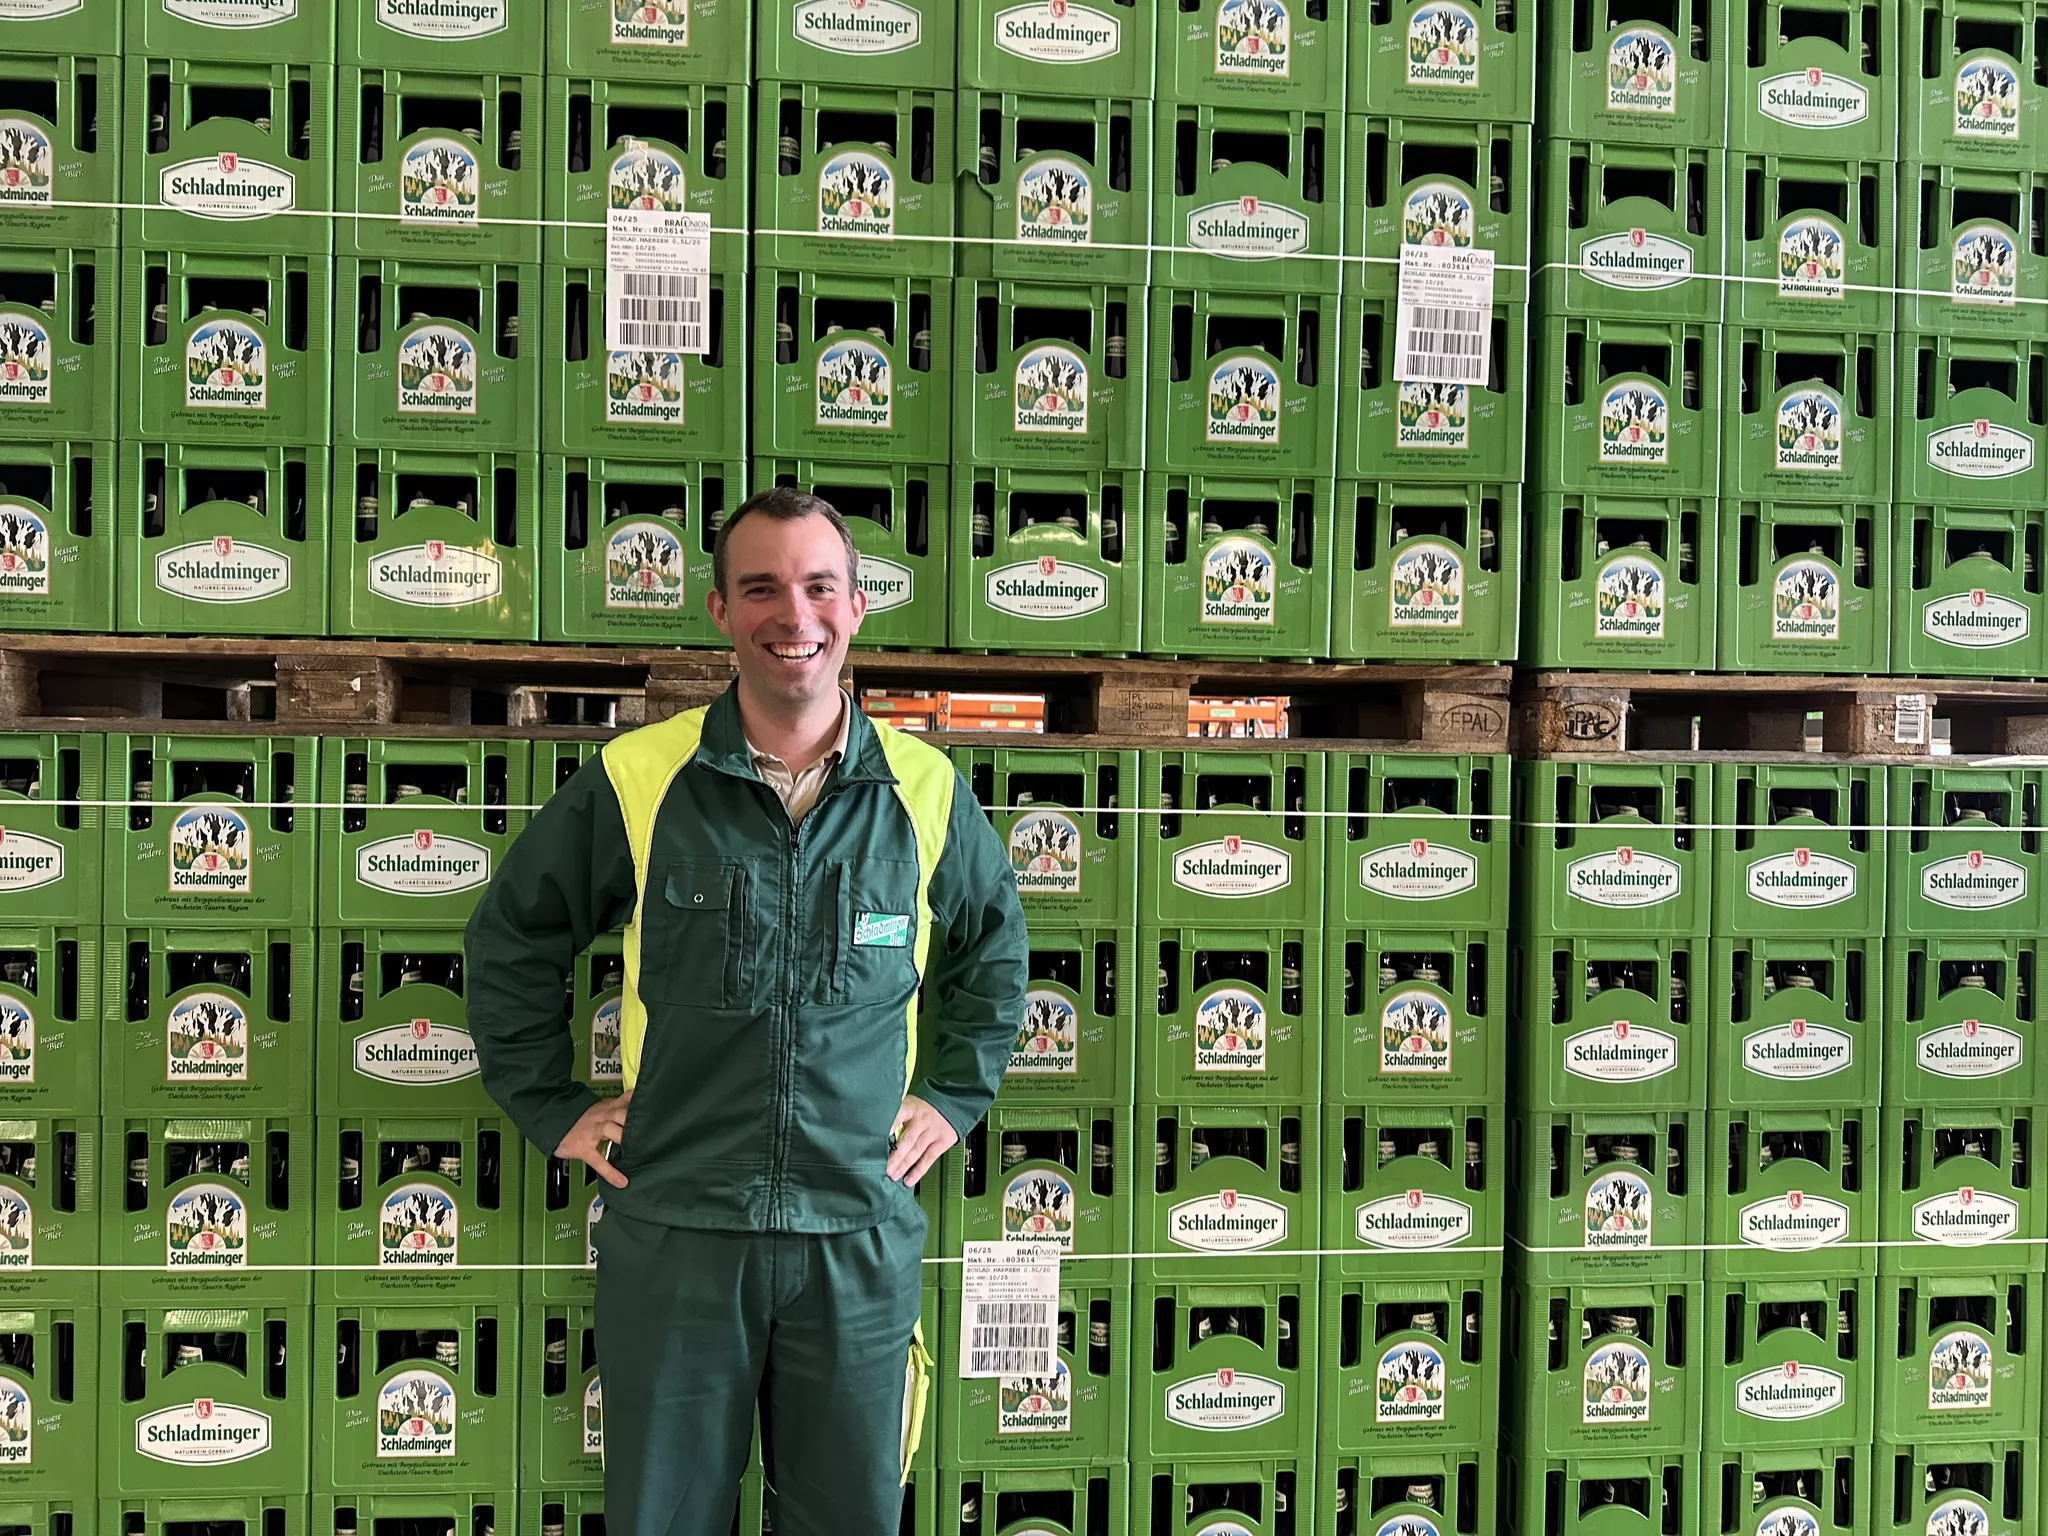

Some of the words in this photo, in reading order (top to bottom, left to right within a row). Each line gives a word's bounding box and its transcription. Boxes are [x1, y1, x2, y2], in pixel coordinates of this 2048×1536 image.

[388, 0, 497, 21] Schladminger
[615, 24, 684, 43] Schladminger
[805, 13, 911, 36] Schladminger
[1006, 21, 1110, 45] Schladminger
[1220, 53, 1285, 72] Schladminger
[1411, 65, 1474, 83] Schladminger
[1611, 91, 1671, 109] Schladminger
[1769, 89, 1859, 112] Schladminger
[1958, 117, 2015, 135] Schladminger
[0, 188, 49, 201] adminger
[173, 177, 284, 201] Schladminger
[405, 205, 475, 218] Schladminger
[822, 217, 890, 234] Schladminger
[1021, 225, 1087, 243] Schladminger
[1198, 220, 1299, 242] Schladminger
[1406, 250, 1428, 258] 06/25
[1590, 251, 1684, 271] Schladminger
[0, 382, 47, 400] dminger
[190, 387, 262, 405] Schladminger
[402, 392, 472, 410] Schladminger
[611, 402, 680, 420] Schladminger
[820, 405, 888, 424] Schladminger
[1018, 412, 1083, 430] Schladminger
[1209, 422, 1275, 439] Schladminger
[1400, 428, 1464, 445] Schladminger
[1604, 443, 1664, 460] Schladminger
[1780, 451, 1838, 467] Schladminger
[1937, 441, 2025, 462] Schladminger
[168, 561, 280, 583] Schladminger
[380, 565, 490, 587] Schladminger
[0, 573, 45, 591] dminger
[996, 580, 1098, 601] Schladminger
[610, 588, 680, 602] Schladminger
[1206, 603, 1269, 620] Schladminger
[1394, 607, 1458, 623] Schladminger
[1600, 619, 1660, 634] Schladminger
[1777, 620, 1835, 636] Schladminger
[1933, 611, 2021, 631] Schladminger
[138, 842, 154, 850] Das
[369, 855, 479, 876] Schladminger
[1183, 859, 1281, 878] Schladminger
[1370, 862, 1467, 881] Schladminger
[174, 872, 247, 889] Schladminger
[1015, 873, 1076, 889] chladminger
[1578, 870, 1672, 889] Schladminger
[1757, 871, 1847, 890] Schladminger
[1931, 873, 2018, 891] Schladminger
[1168, 1024, 1182, 1033] Das
[366, 1044, 475, 1065] Schladminger
[1198, 1052, 1262, 1067] Schladminger
[1575, 1045, 1668, 1062] Schladminger
[1753, 1043, 1843, 1060] Schladminger
[1927, 1042, 2014, 1060] Schladminger
[171, 1060, 243, 1077] Schladminger
[1009, 1054, 1073, 1070] Schladminger
[1385, 1054, 1447, 1069] Schladminger
[134, 1223, 150, 1232] Das
[348, 1222, 364, 1230] Das
[1179, 1214, 1277, 1233] Schladminger
[1366, 1213, 1462, 1231] Schladminger
[1750, 1214, 1840, 1231] Schladminger
[1922, 1210, 2009, 1227] Schladminger
[1588, 1233, 1647, 1246] Schladminger
[170, 1252, 243, 1266] Schladminger
[383, 1250, 454, 1265] Schladminger
[1176, 1392, 1275, 1410] Schladminger
[1746, 1384, 1835, 1401] Schladminger
[1932, 1391, 1988, 1405] Schladminger
[1380, 1403, 1441, 1417] Schladminger
[1586, 1405, 1646, 1418] Schladminger
[1002, 1414, 1067, 1429] Schladminger
[148, 1424, 260, 1443] Schladminger
[381, 1438, 451, 1453] Schladminger
